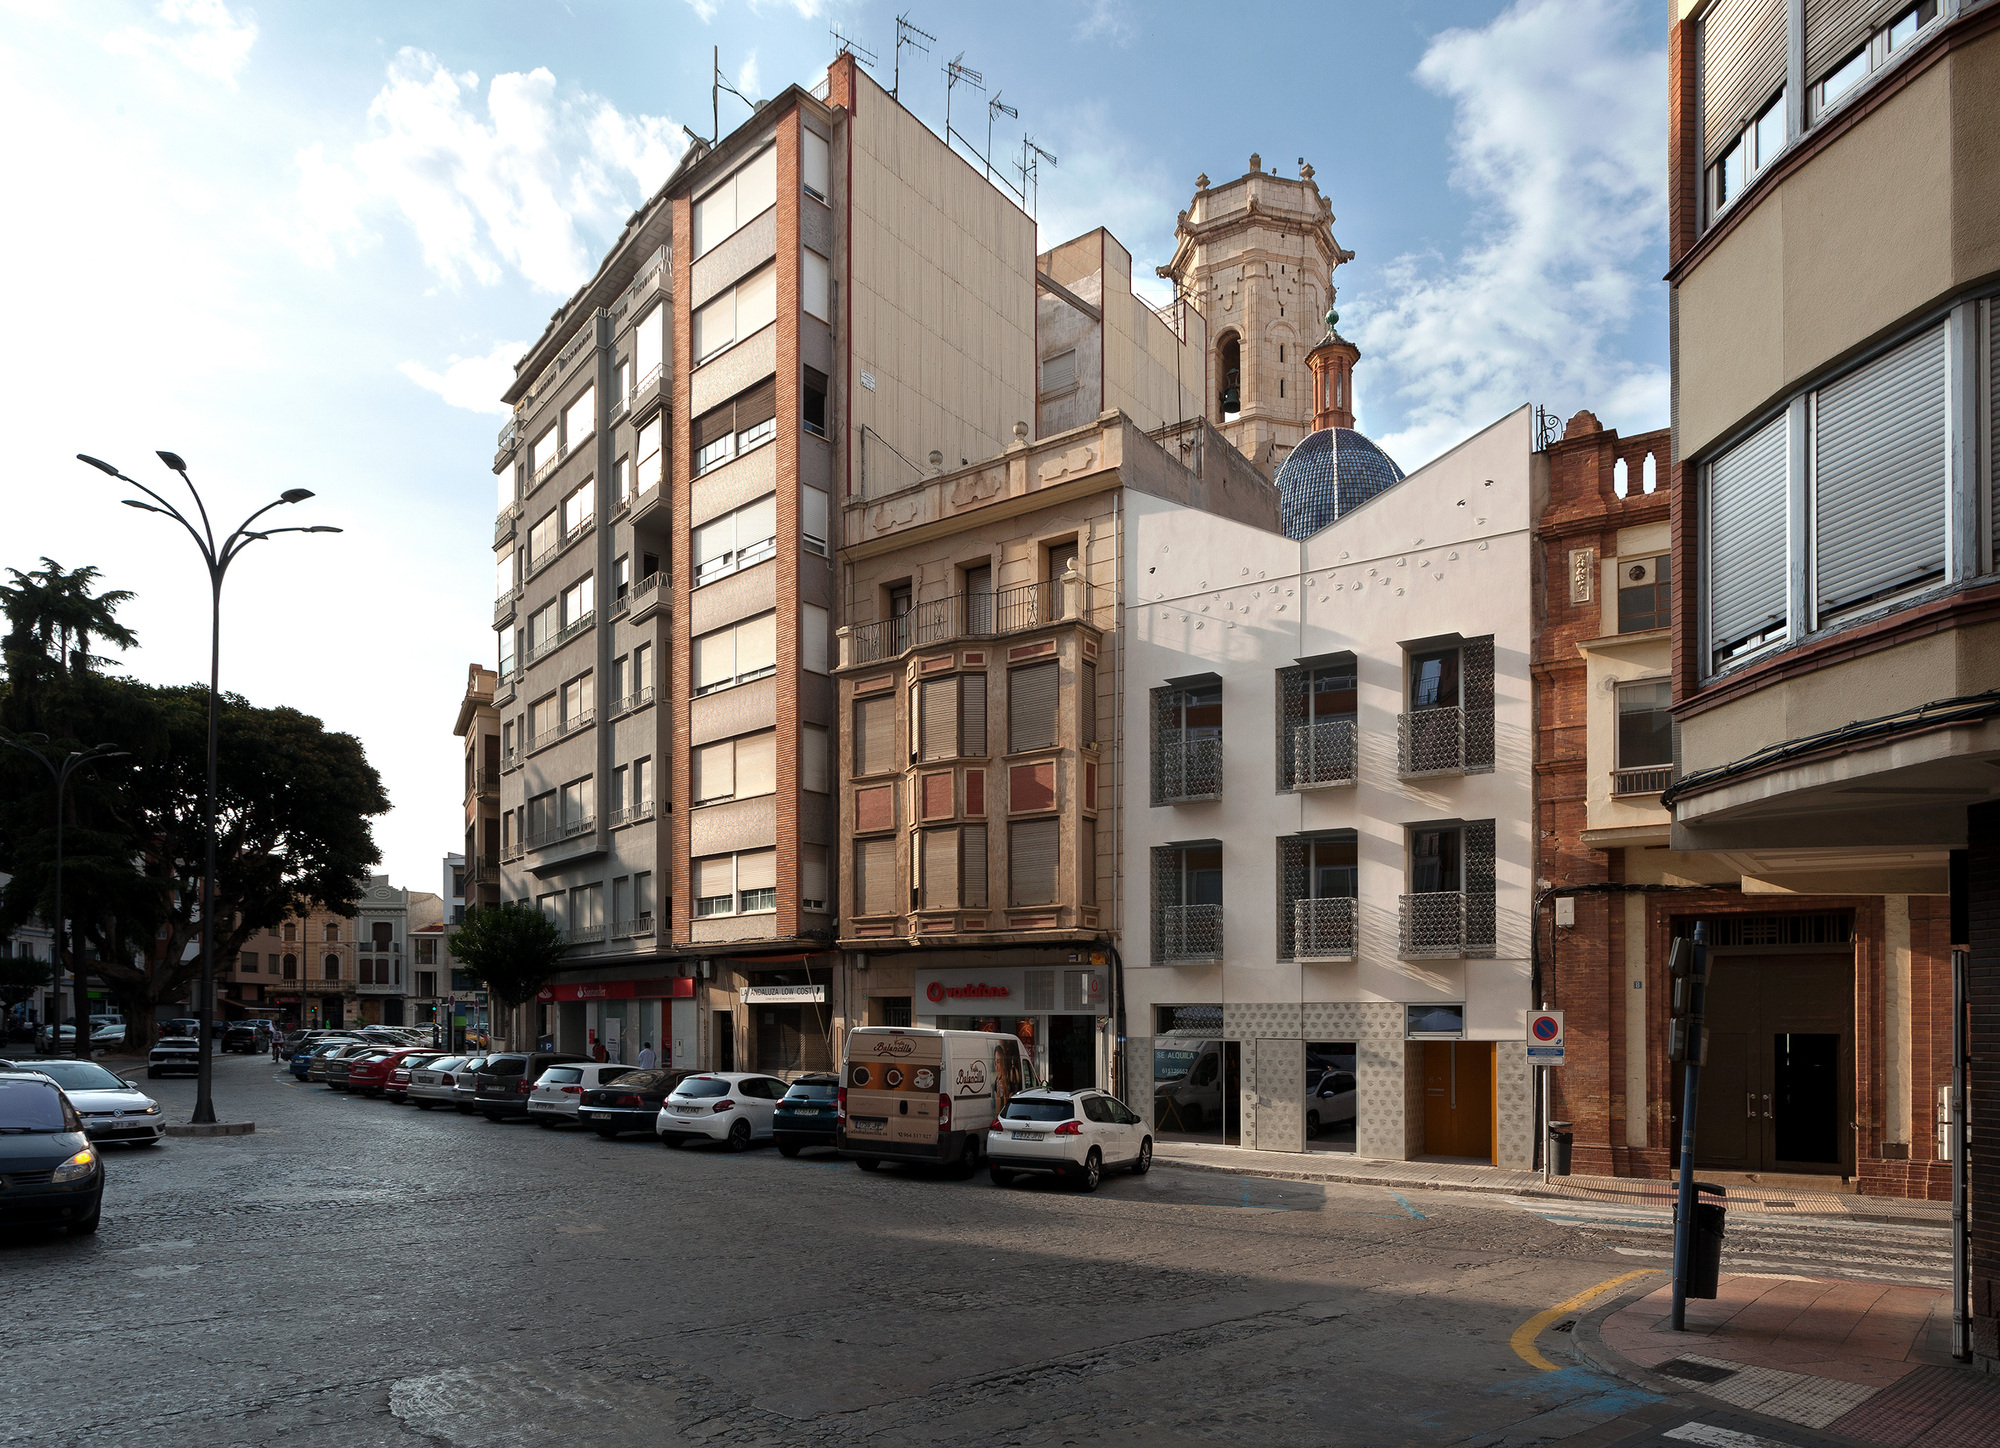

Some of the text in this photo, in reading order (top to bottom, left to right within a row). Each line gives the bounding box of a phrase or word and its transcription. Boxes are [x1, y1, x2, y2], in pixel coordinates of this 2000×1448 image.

[584, 984, 606, 997] Santander
[751, 987, 778, 996] ANDALUZA
[781, 987, 794, 995] LOW
[796, 986, 812, 994] COST
[945, 982, 1009, 998] vodafone
